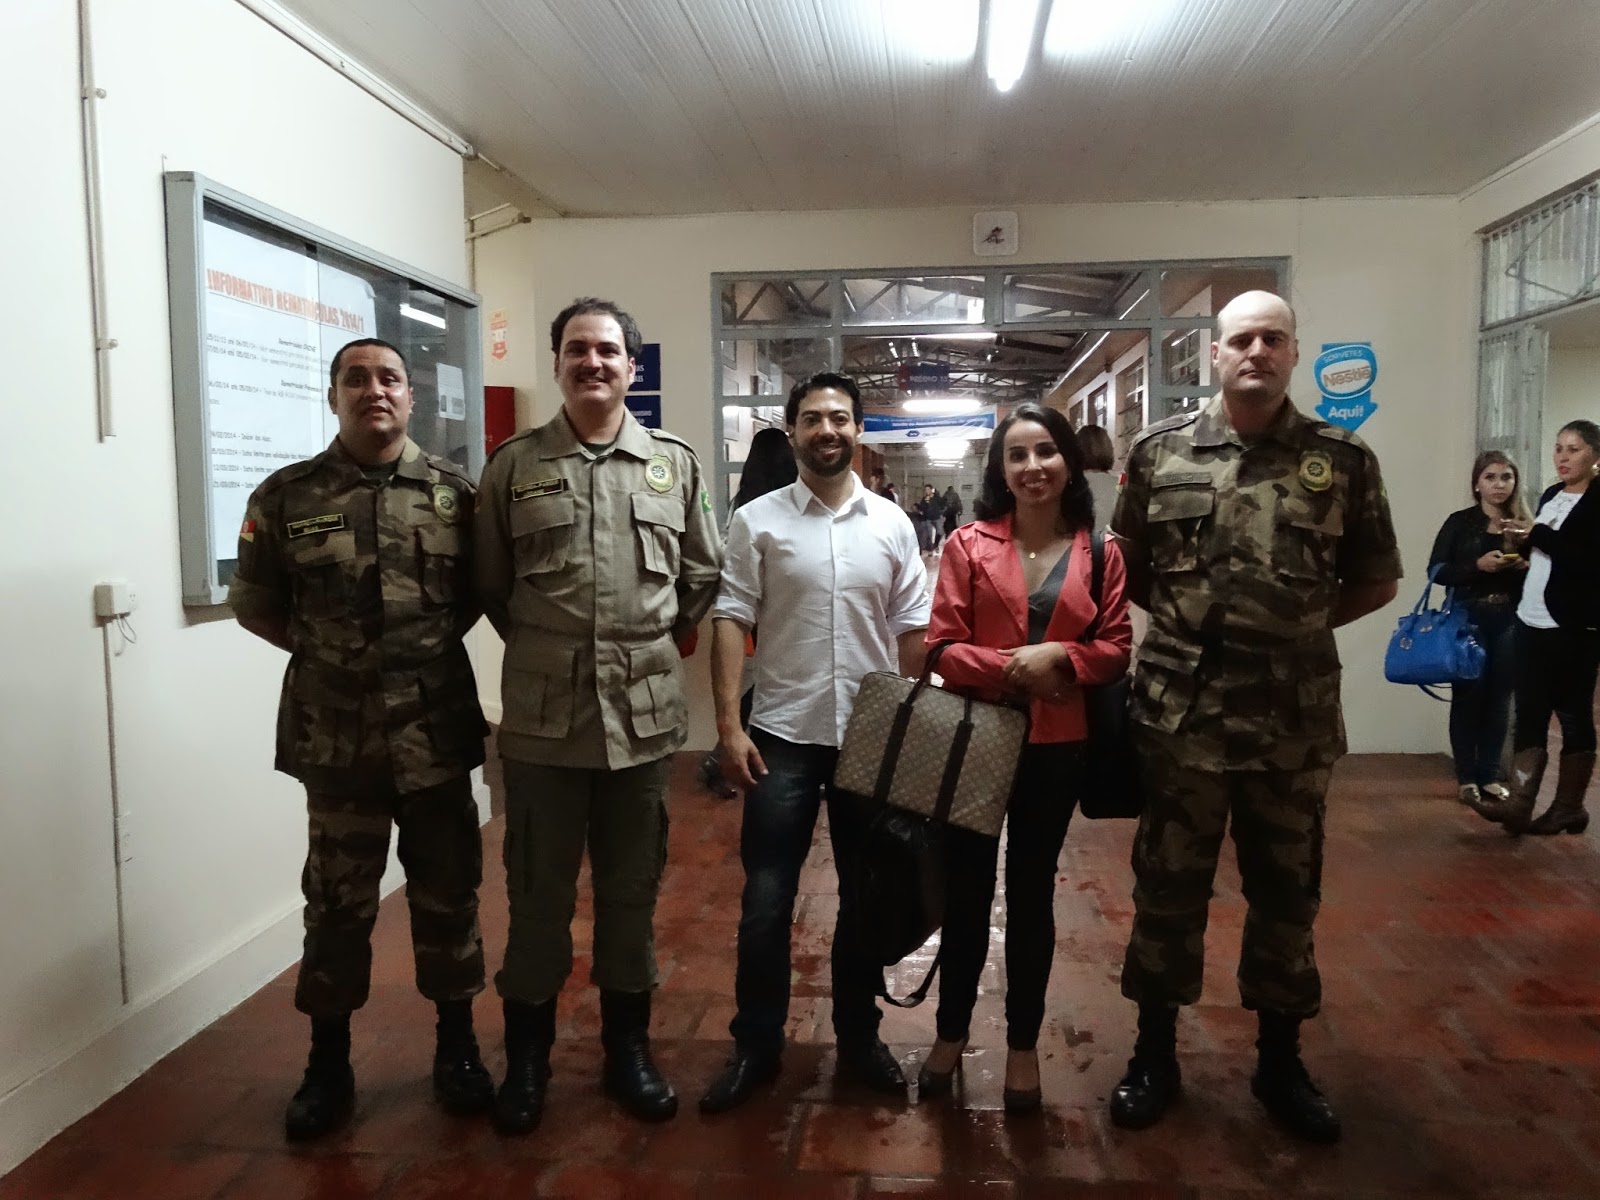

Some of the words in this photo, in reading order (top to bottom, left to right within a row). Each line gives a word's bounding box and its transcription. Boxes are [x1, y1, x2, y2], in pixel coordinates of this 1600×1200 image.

[207, 268, 274, 308] INFORMATIVO
[340, 308, 364, 334] 2014/1
[1324, 350, 1362, 363] SORVETES
